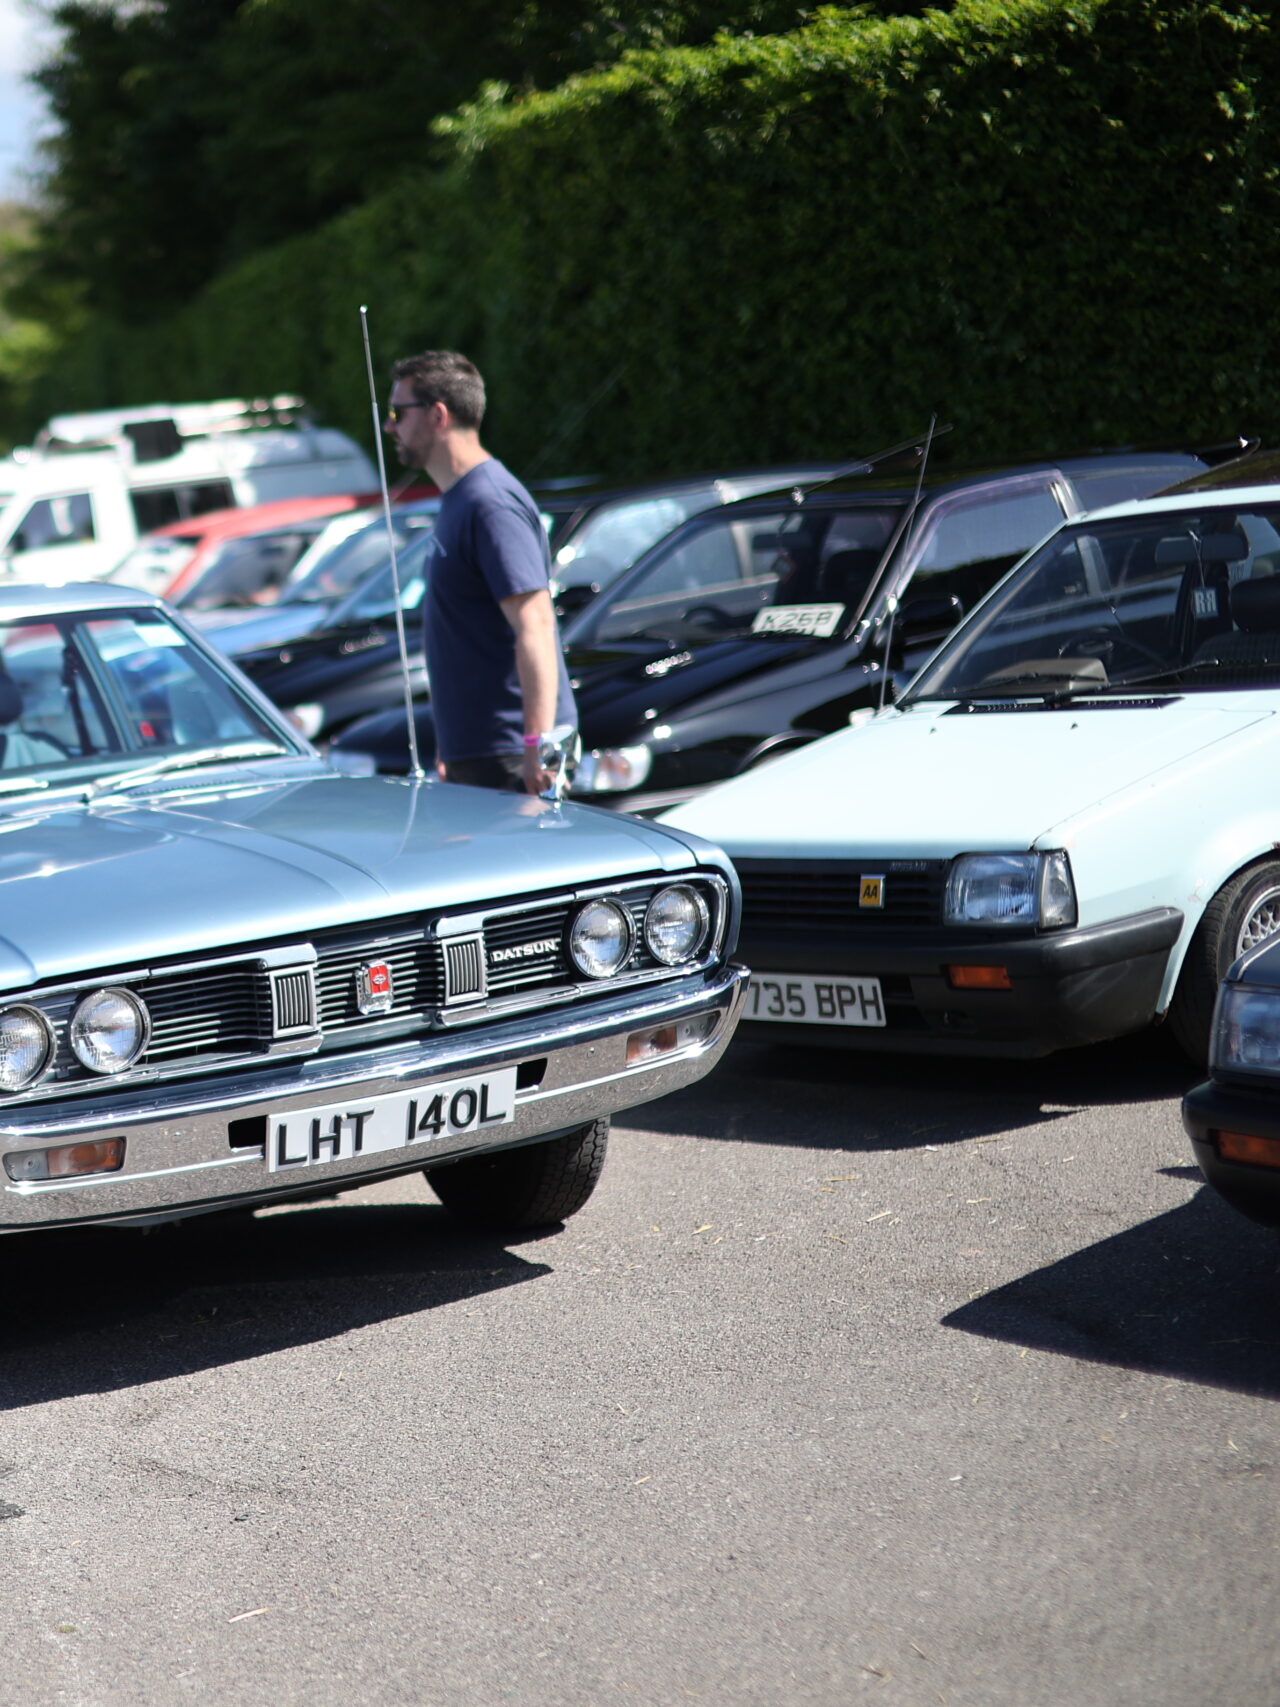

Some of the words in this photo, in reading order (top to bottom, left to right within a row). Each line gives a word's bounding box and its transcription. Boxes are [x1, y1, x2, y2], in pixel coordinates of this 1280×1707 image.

[863, 885, 878, 899] AA
[492, 939, 561, 962] DATSUN
[814, 983, 882, 1021] BPH
[277, 1105, 375, 1166] LHT
[407, 1081, 507, 1141] 140L
